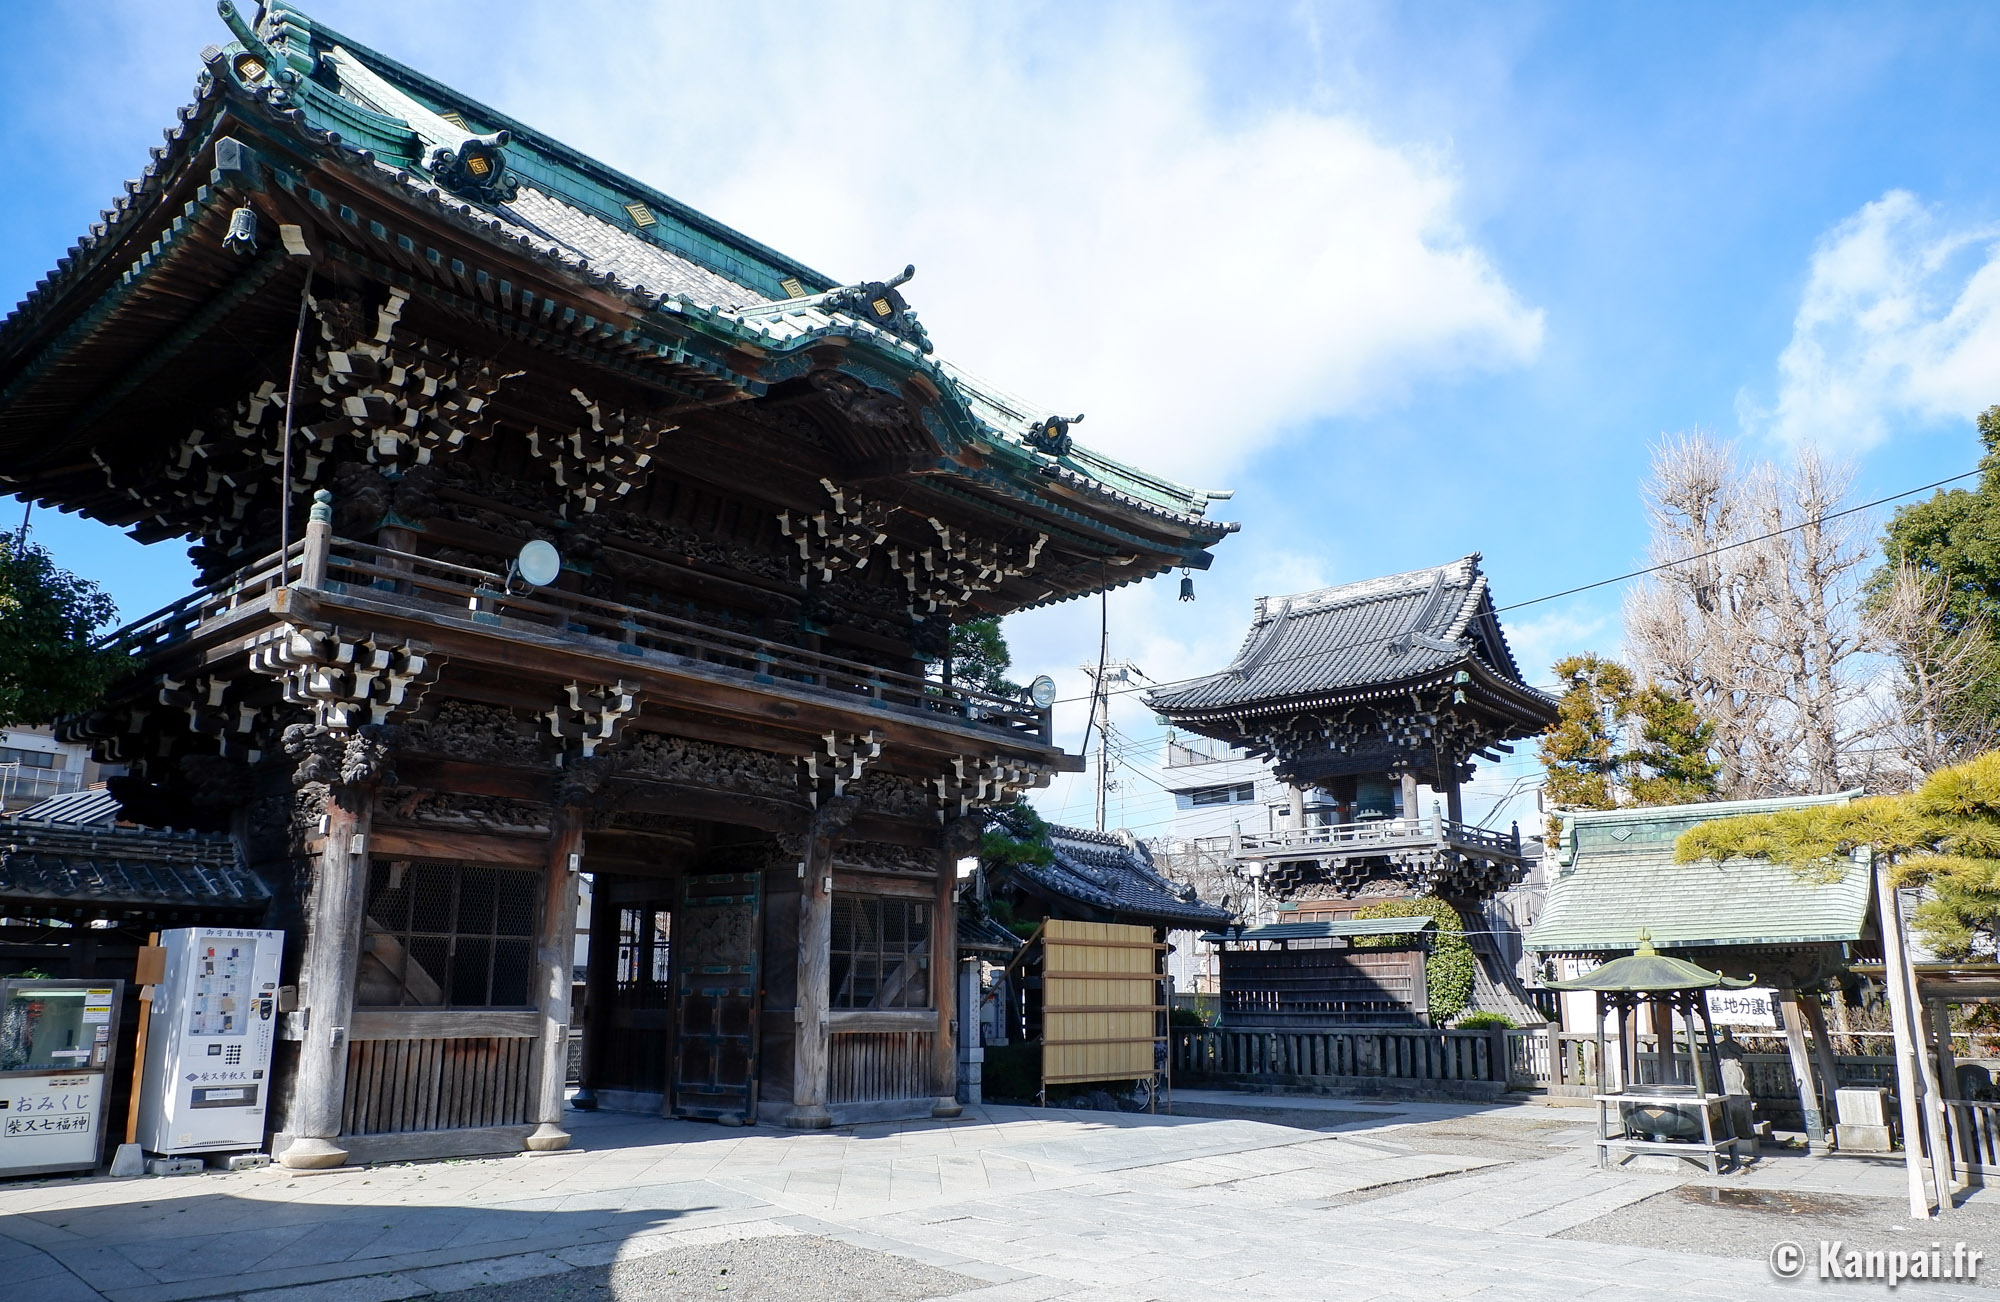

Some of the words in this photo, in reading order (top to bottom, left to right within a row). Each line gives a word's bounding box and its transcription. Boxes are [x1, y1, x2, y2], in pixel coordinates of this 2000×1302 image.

[16, 1094, 89, 1112] おみくじ
[7, 1116, 87, 1134] 柴又七福神
